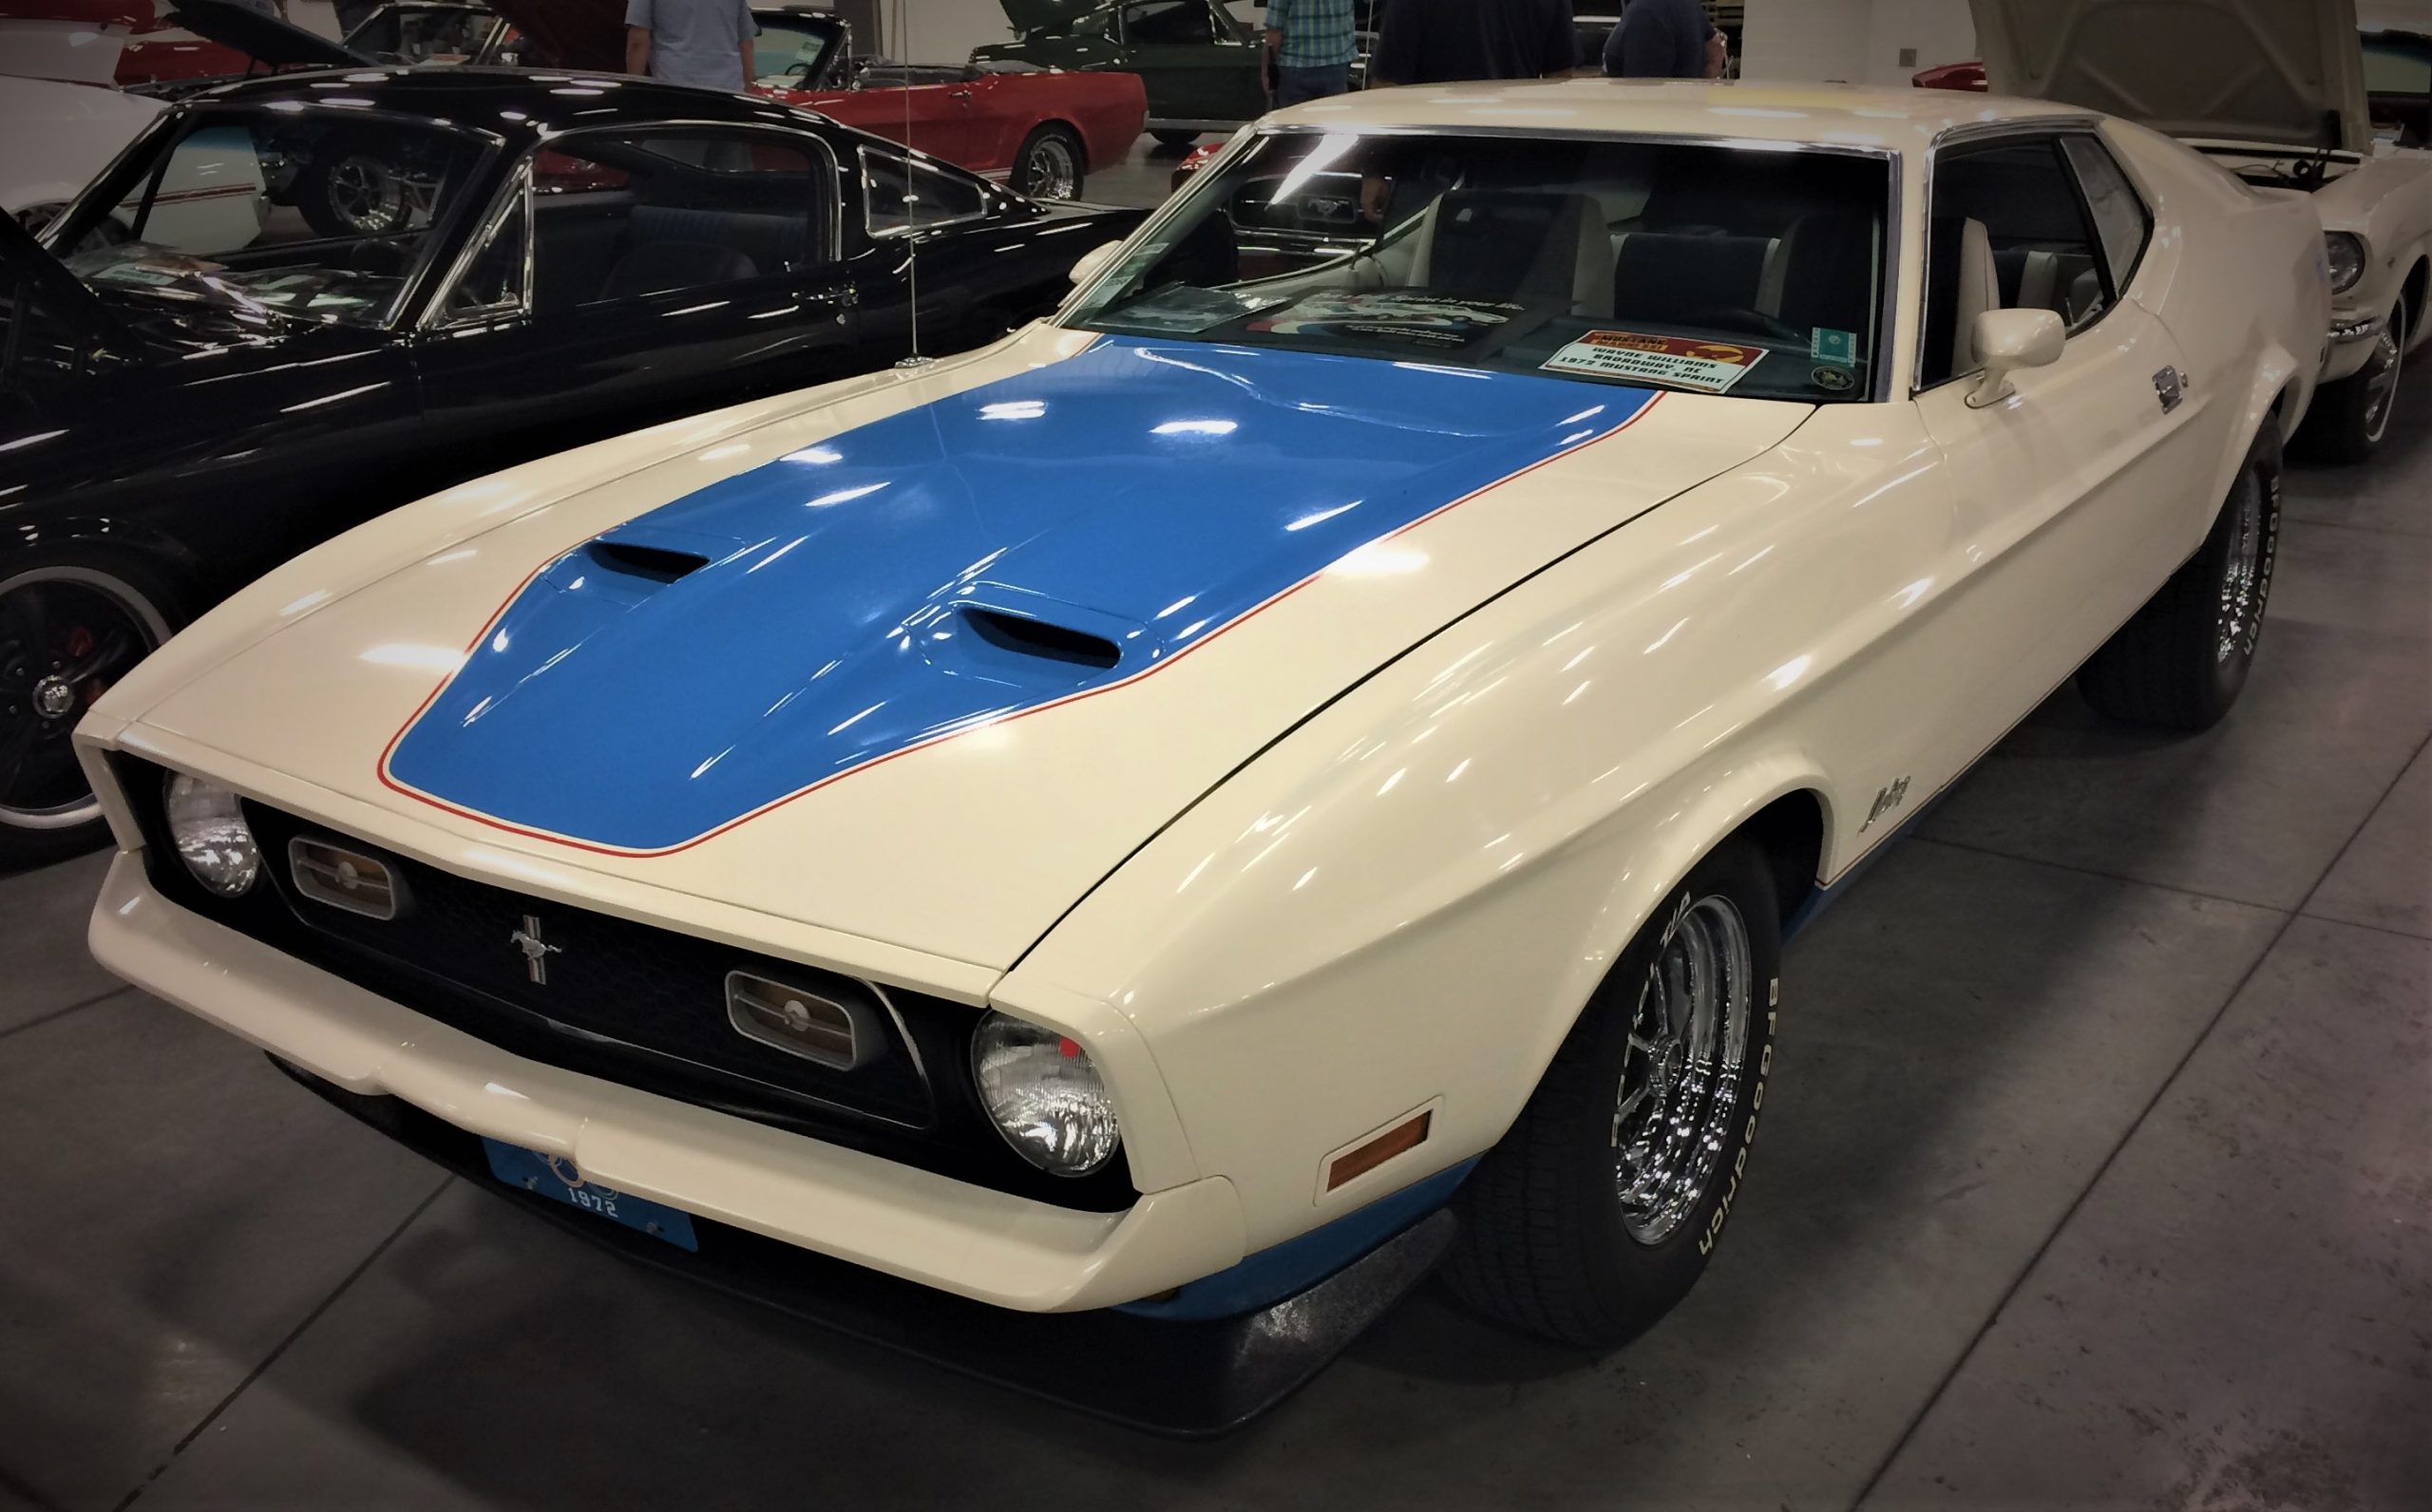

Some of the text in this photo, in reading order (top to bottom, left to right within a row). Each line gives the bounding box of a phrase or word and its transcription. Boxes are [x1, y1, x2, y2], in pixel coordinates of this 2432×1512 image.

[1560, 356, 1724, 384] 1972 MUSTANG SPRINT
[1592, 347, 1718, 369] WAYNE WILLIAMS
[1699, 978, 1778, 1257] BFGoodrich
[568, 1187, 618, 1218] 1972
